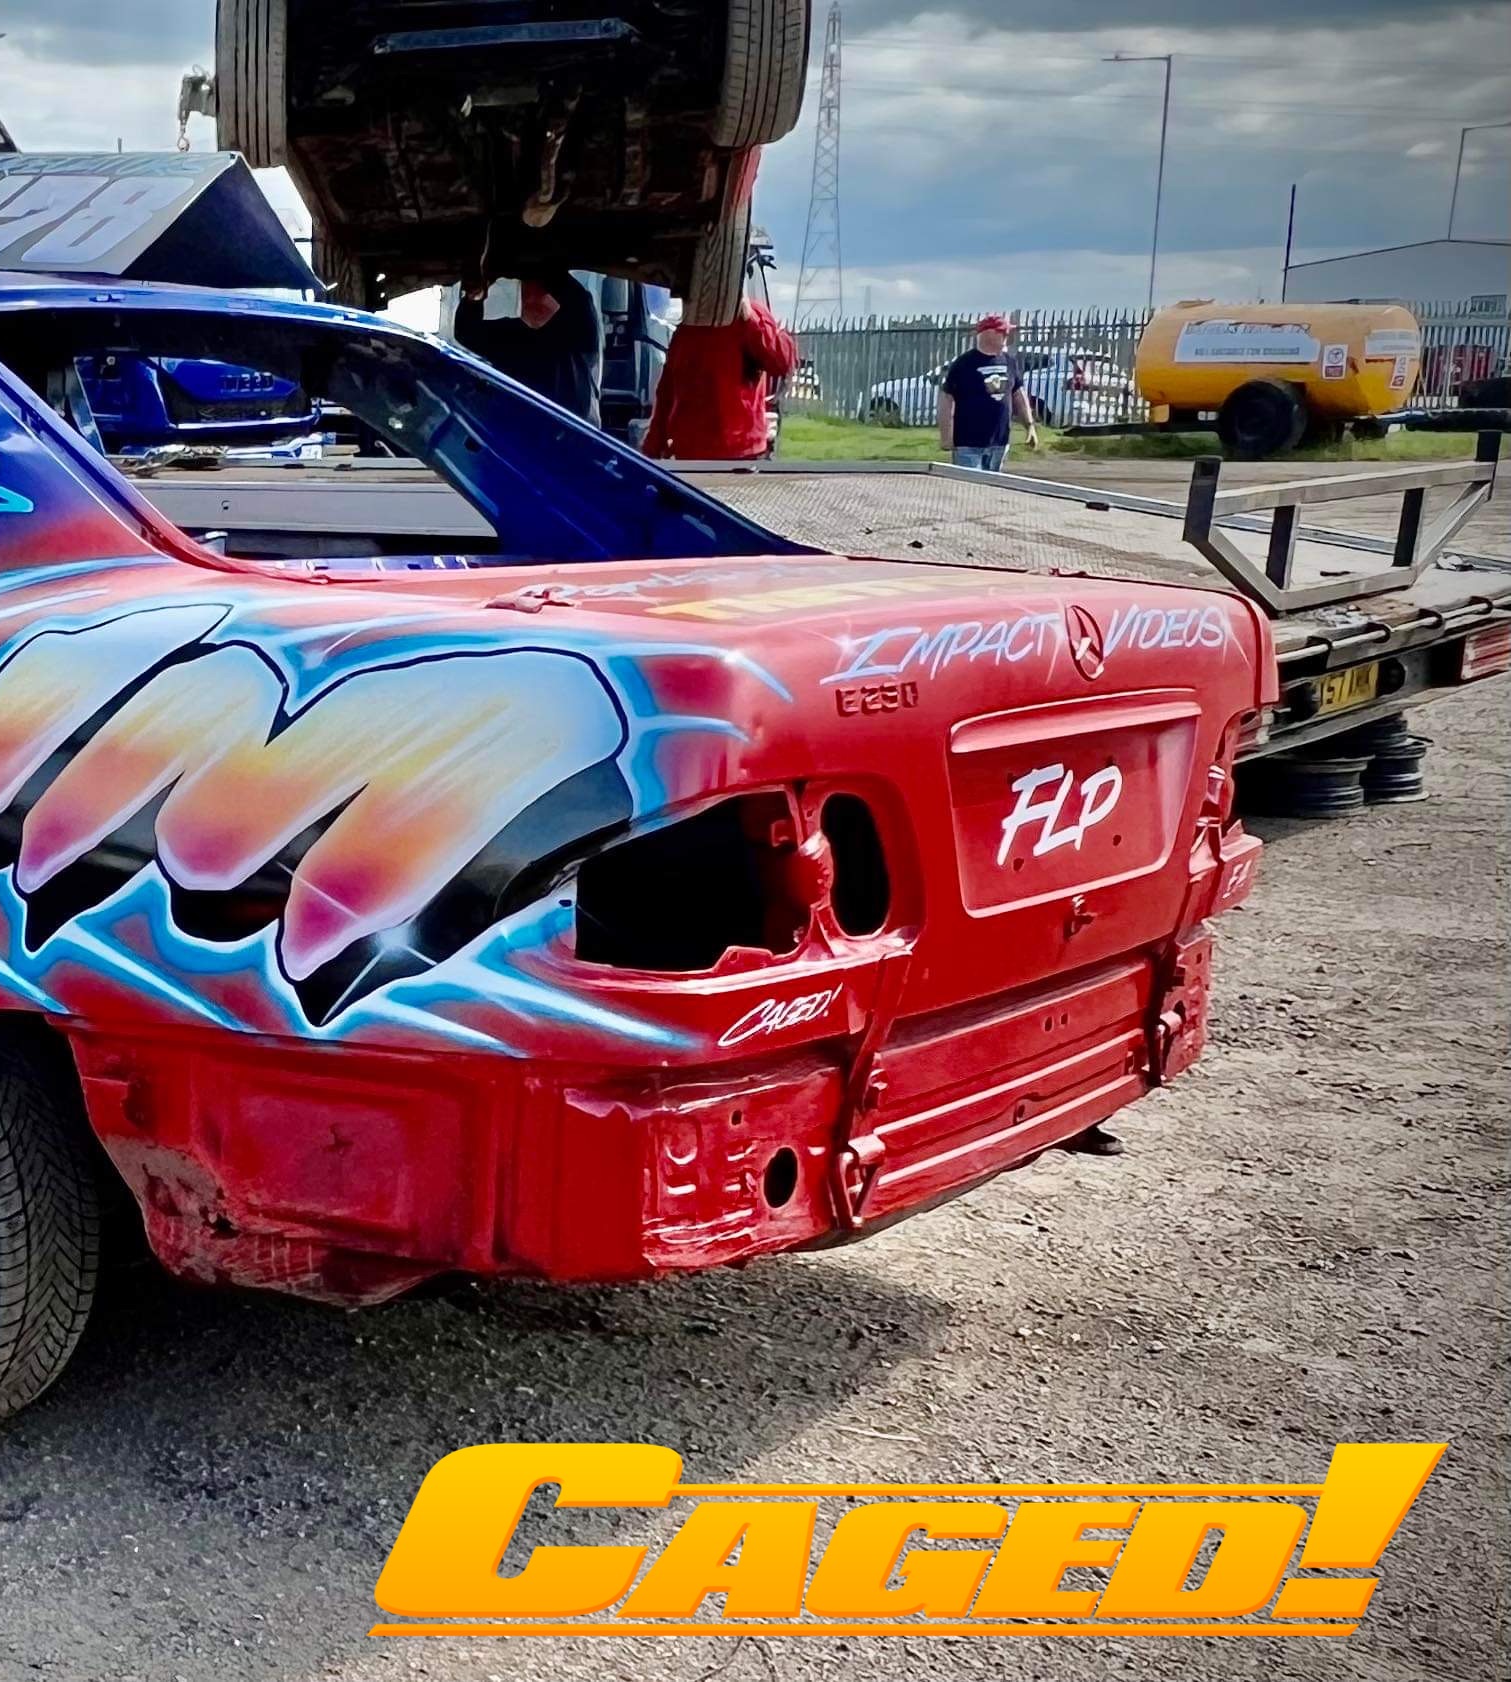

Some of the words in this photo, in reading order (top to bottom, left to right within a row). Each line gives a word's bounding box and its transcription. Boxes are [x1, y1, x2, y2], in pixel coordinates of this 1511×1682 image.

[819, 612, 1061, 686] IMPACT
[1103, 603, 1225, 657] VIDEOS
[996, 762, 1123, 866] FLP
[717, 981, 844, 1047] CAGED!
